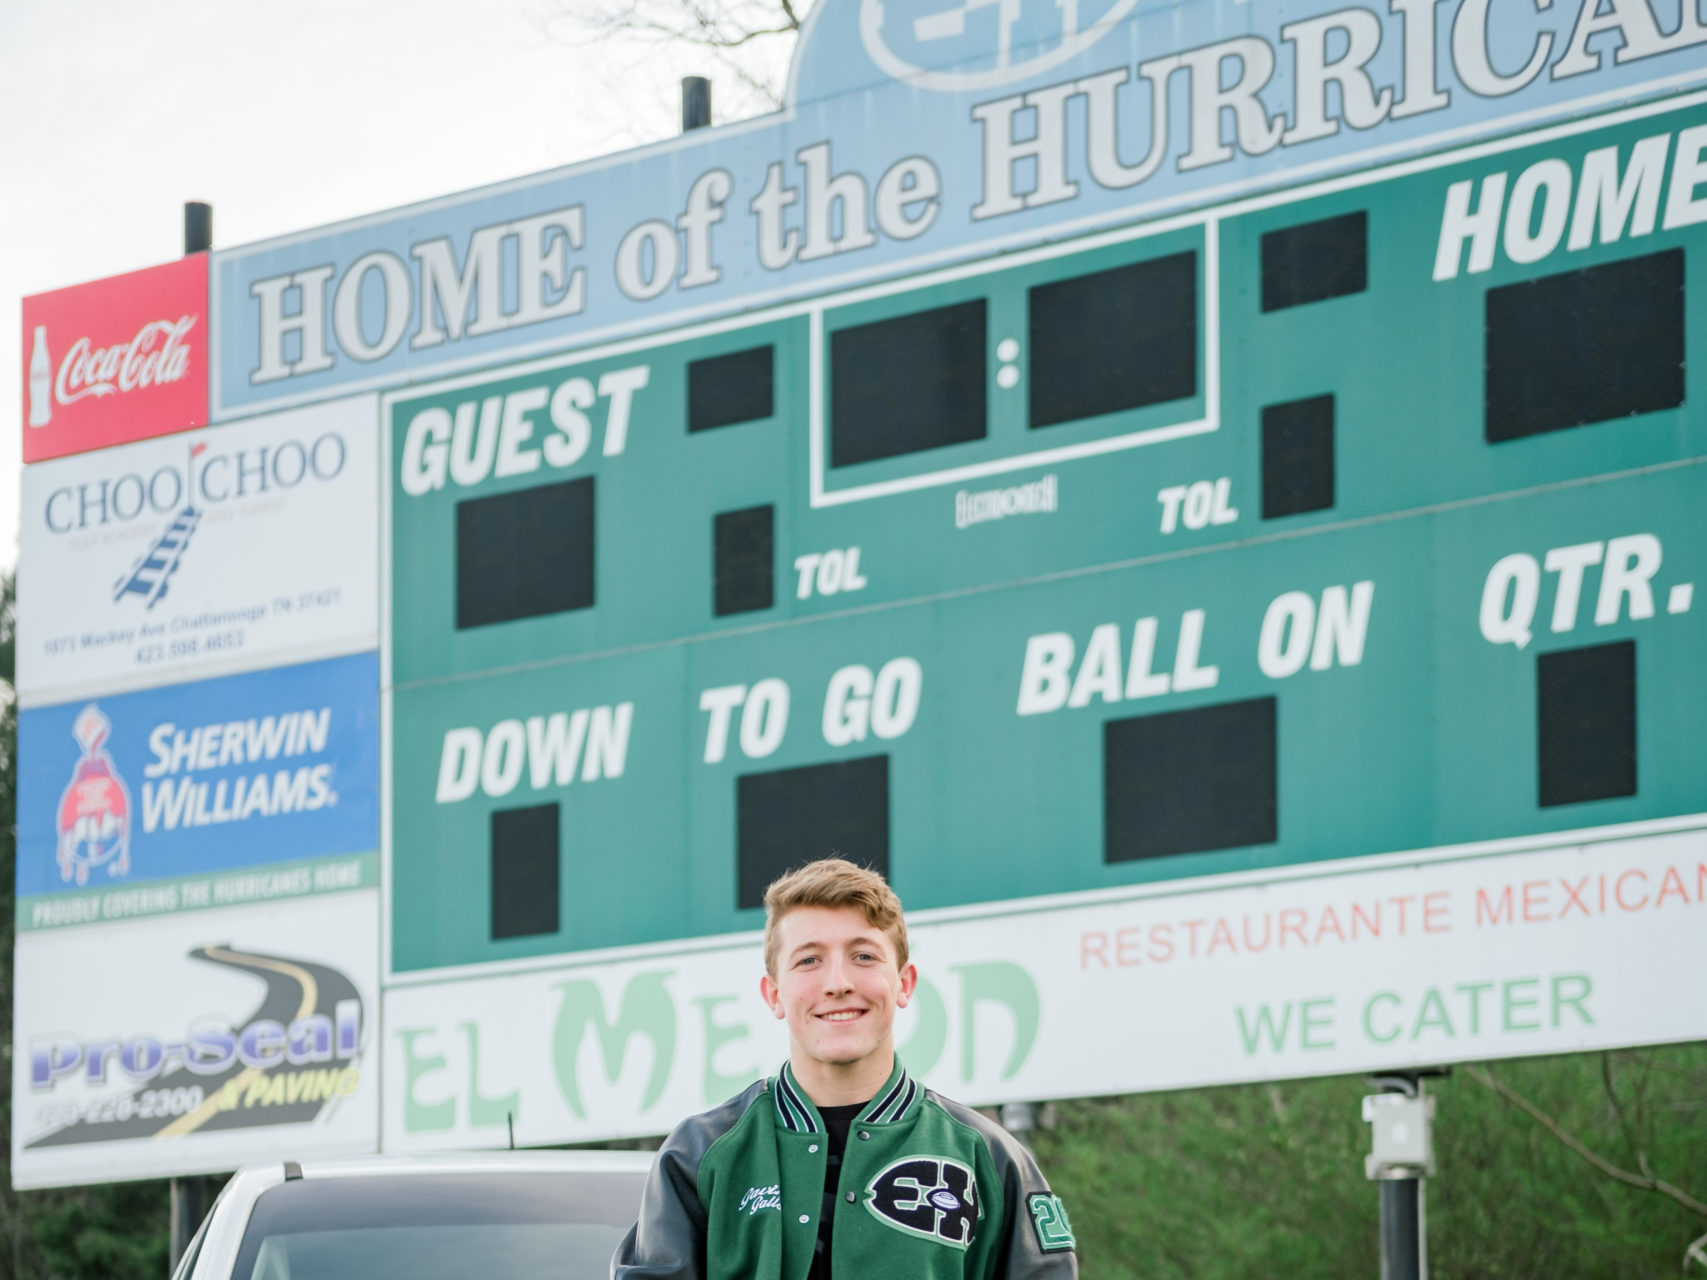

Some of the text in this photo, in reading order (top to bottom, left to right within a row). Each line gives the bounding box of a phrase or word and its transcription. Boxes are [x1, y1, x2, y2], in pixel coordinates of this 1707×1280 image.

[250, 203, 586, 386] HOME
[615, 168, 735, 301] of
[751, 140, 942, 272] the
[971, 0, 1707, 221] HURRICA
[1432, 122, 1707, 282] HOME
[55, 313, 199, 406] Coca-Cola
[401, 365, 650, 497] GUEST
[45, 432, 347, 535] CHOO CHOO
[1157, 478, 1239, 534] TOL
[794, 546, 868, 600] TOL
[1477, 533, 1694, 650] QTR.
[1016, 580, 1375, 716] BALL ON
[144, 707, 331, 778] SHERWIN
[435, 701, 634, 803] DOWN
[699, 656, 923, 764] TO GO
[181, 879, 210, 903] THE
[1080, 891, 1452, 971] RESTAURANTE
[1235, 973, 1597, 1057] WE CATER
[243, 1067, 360, 1108] PAVING
[394, 1018, 519, 1134] EL
